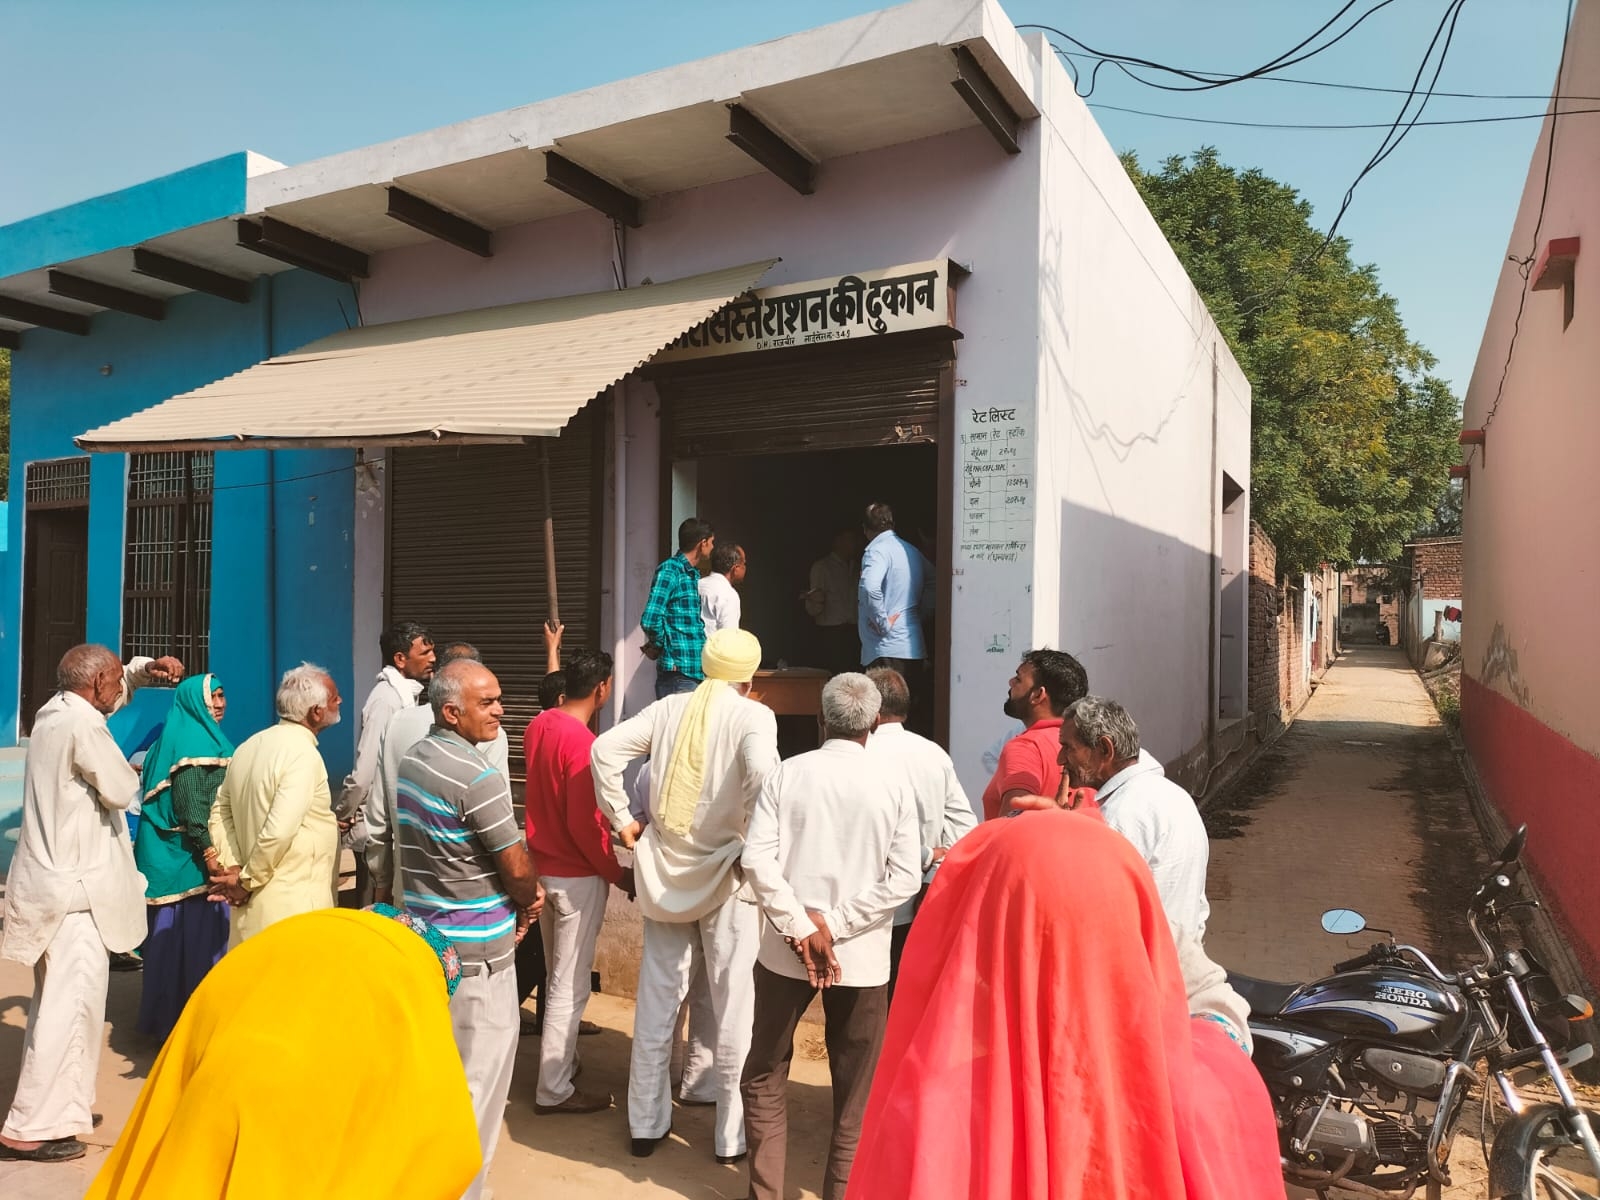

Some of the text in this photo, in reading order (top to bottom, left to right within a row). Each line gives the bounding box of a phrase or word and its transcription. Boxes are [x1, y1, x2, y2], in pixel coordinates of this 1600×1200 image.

[762, 288, 831, 338] राशन
[829, 275, 867, 327] की
[866, 269, 939, 335] दुकान
[971, 406, 1016, 423] रेट लिस्ट
[1375, 991, 1433, 1009] HONDA
[1381, 984, 1427, 999] HERO
